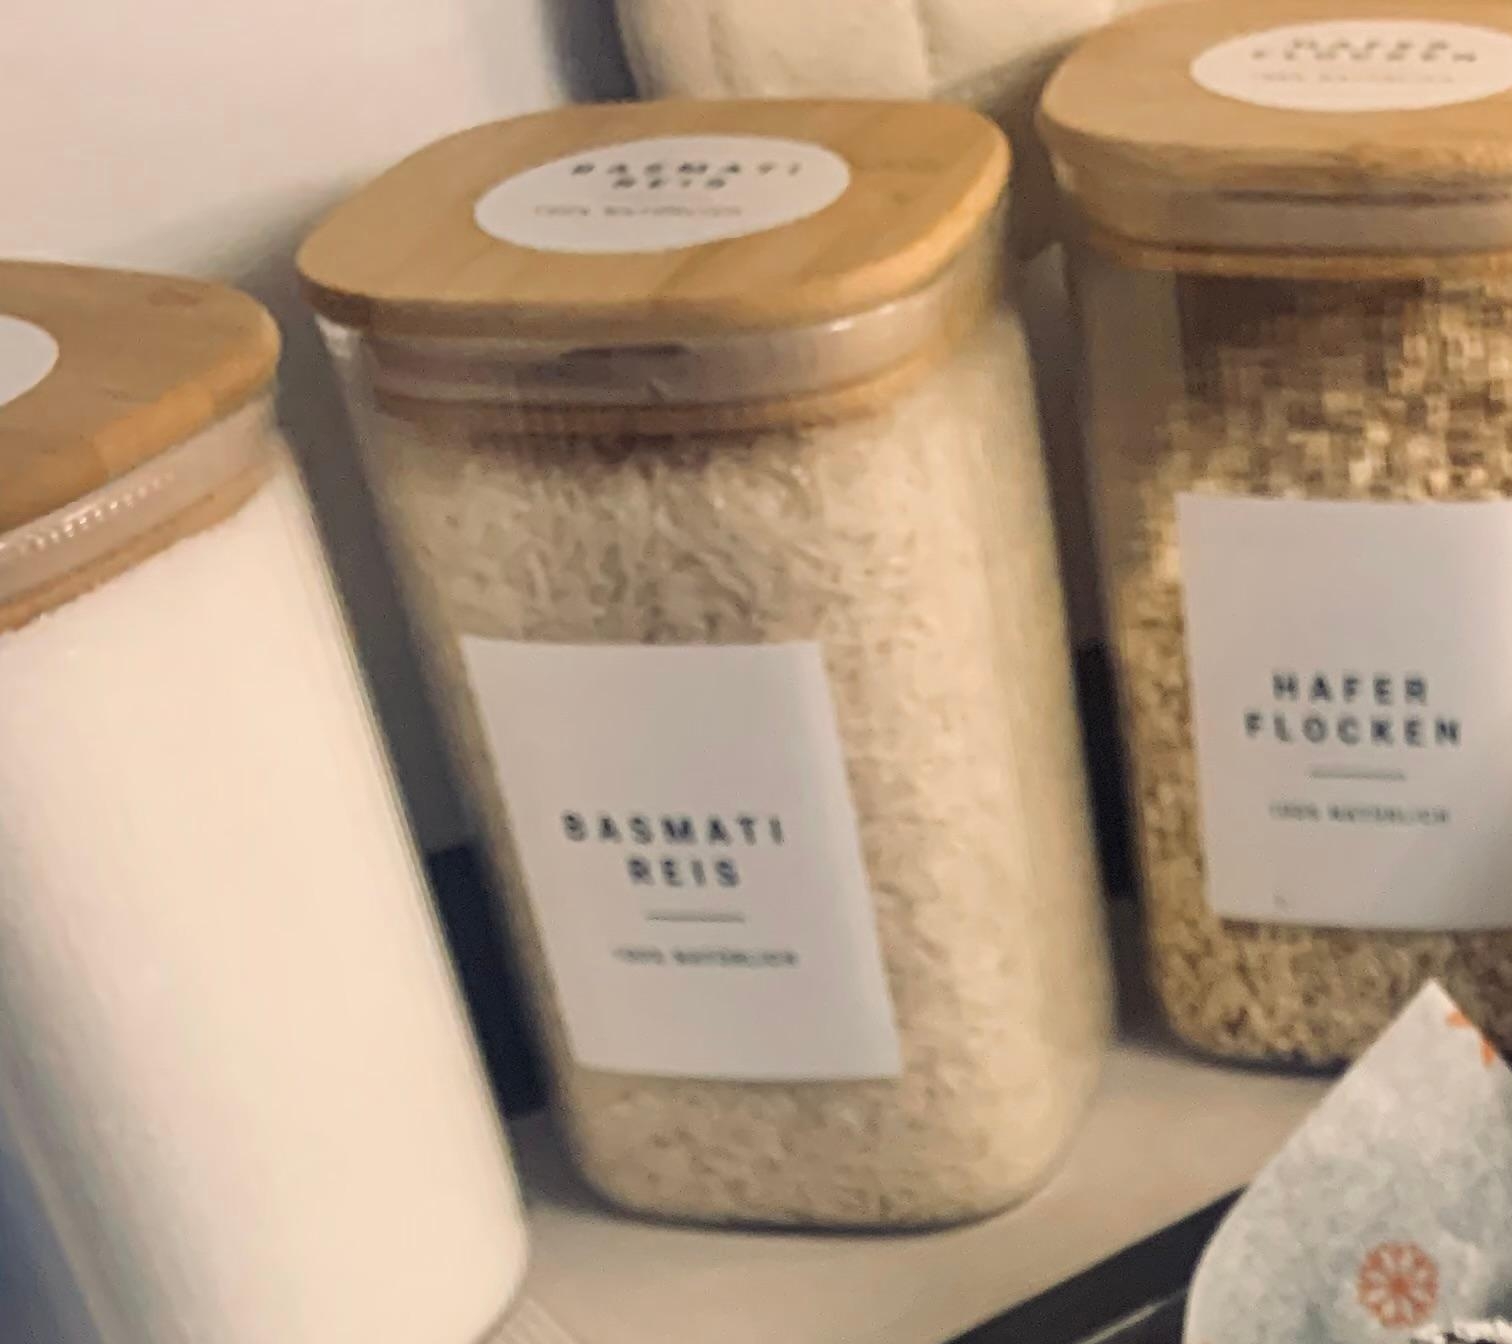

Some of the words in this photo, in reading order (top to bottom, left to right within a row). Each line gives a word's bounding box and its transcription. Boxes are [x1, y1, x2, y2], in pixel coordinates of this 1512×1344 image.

[1272, 671, 1429, 706] HAFER
[1244, 708, 1461, 748] FLOCKEN
[560, 810, 785, 846] BASMATI
[627, 855, 740, 888] REIS
